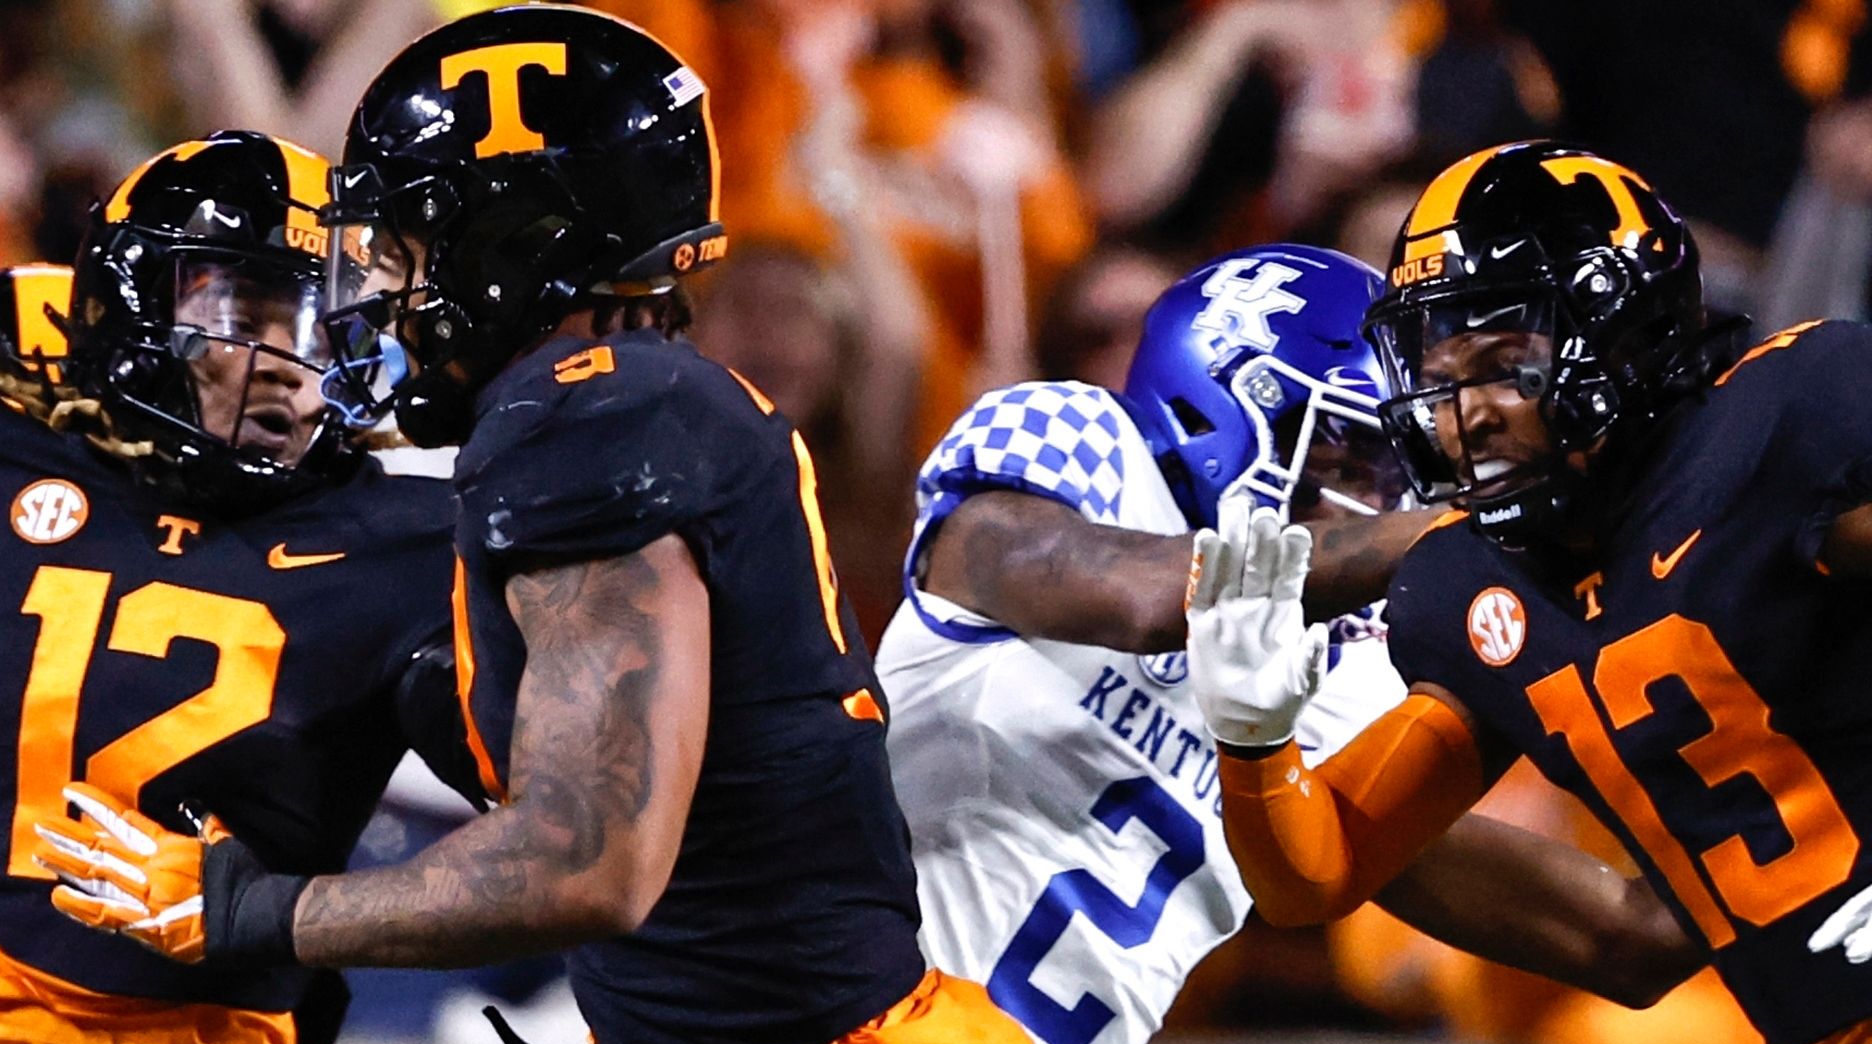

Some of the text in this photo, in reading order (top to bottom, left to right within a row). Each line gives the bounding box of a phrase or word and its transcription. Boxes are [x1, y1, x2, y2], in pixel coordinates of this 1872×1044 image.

[441, 42, 566, 159] T
[1539, 157, 1655, 247] T
[1392, 254, 1444, 288] VOLS
[14, 480, 86, 541] SEC
[157, 515, 201, 555] T
[1471, 592, 1523, 661] SEC
[1574, 571, 1603, 621] T
[9, 565, 287, 881] 12
[1080, 666, 1224, 820] KENTU
[1526, 612, 1860, 950] 13
